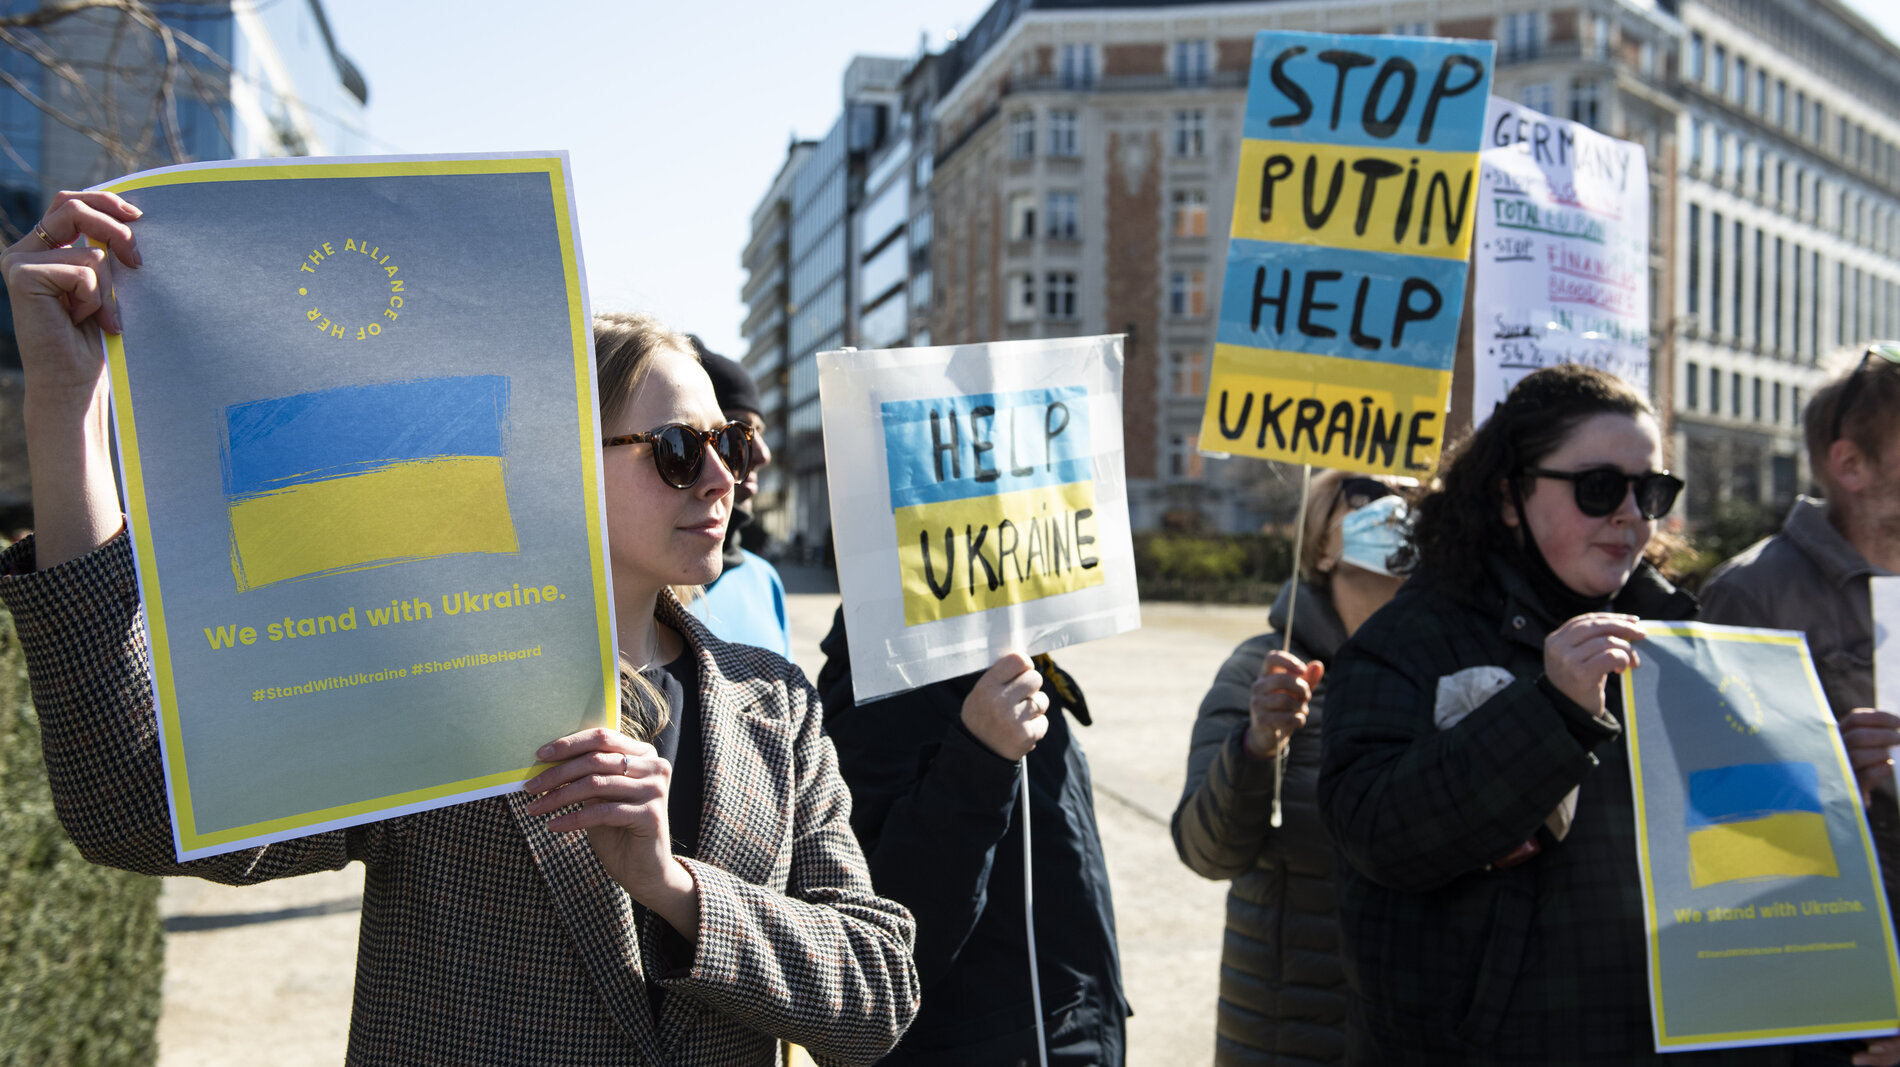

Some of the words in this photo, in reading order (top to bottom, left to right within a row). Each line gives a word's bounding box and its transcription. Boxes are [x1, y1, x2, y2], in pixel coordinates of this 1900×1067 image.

[1269, 45, 1484, 144] STOP
[1493, 111, 1630, 192] GERMANY
[1259, 153, 1474, 246] PUTIN
[300, 242, 335, 273] THE
[344, 238, 405, 321] ALLIANCE
[1495, 237, 1534, 255] STOP
[306, 307, 345, 339] HER
[356, 322, 382, 340] OF
[1250, 266, 1443, 350] HELP
[929, 401, 1070, 482] HELP
[1218, 390, 1436, 471] UKRAINE
[920, 502, 1099, 601] UKRAINE
[203, 623, 258, 650] We
[266, 607, 358, 642] stand
[365, 599, 433, 628] with
[441, 583, 566, 616] Ukraine.
[251, 667, 408, 702] #StandWithUkraine
[411, 645, 542, 676] #SheWillBeHeard
[1674, 907, 1702, 924] We
[1707, 904, 1755, 922] stand
[1759, 902, 1798, 918] with
[1801, 898, 1866, 916] Ukraine.
